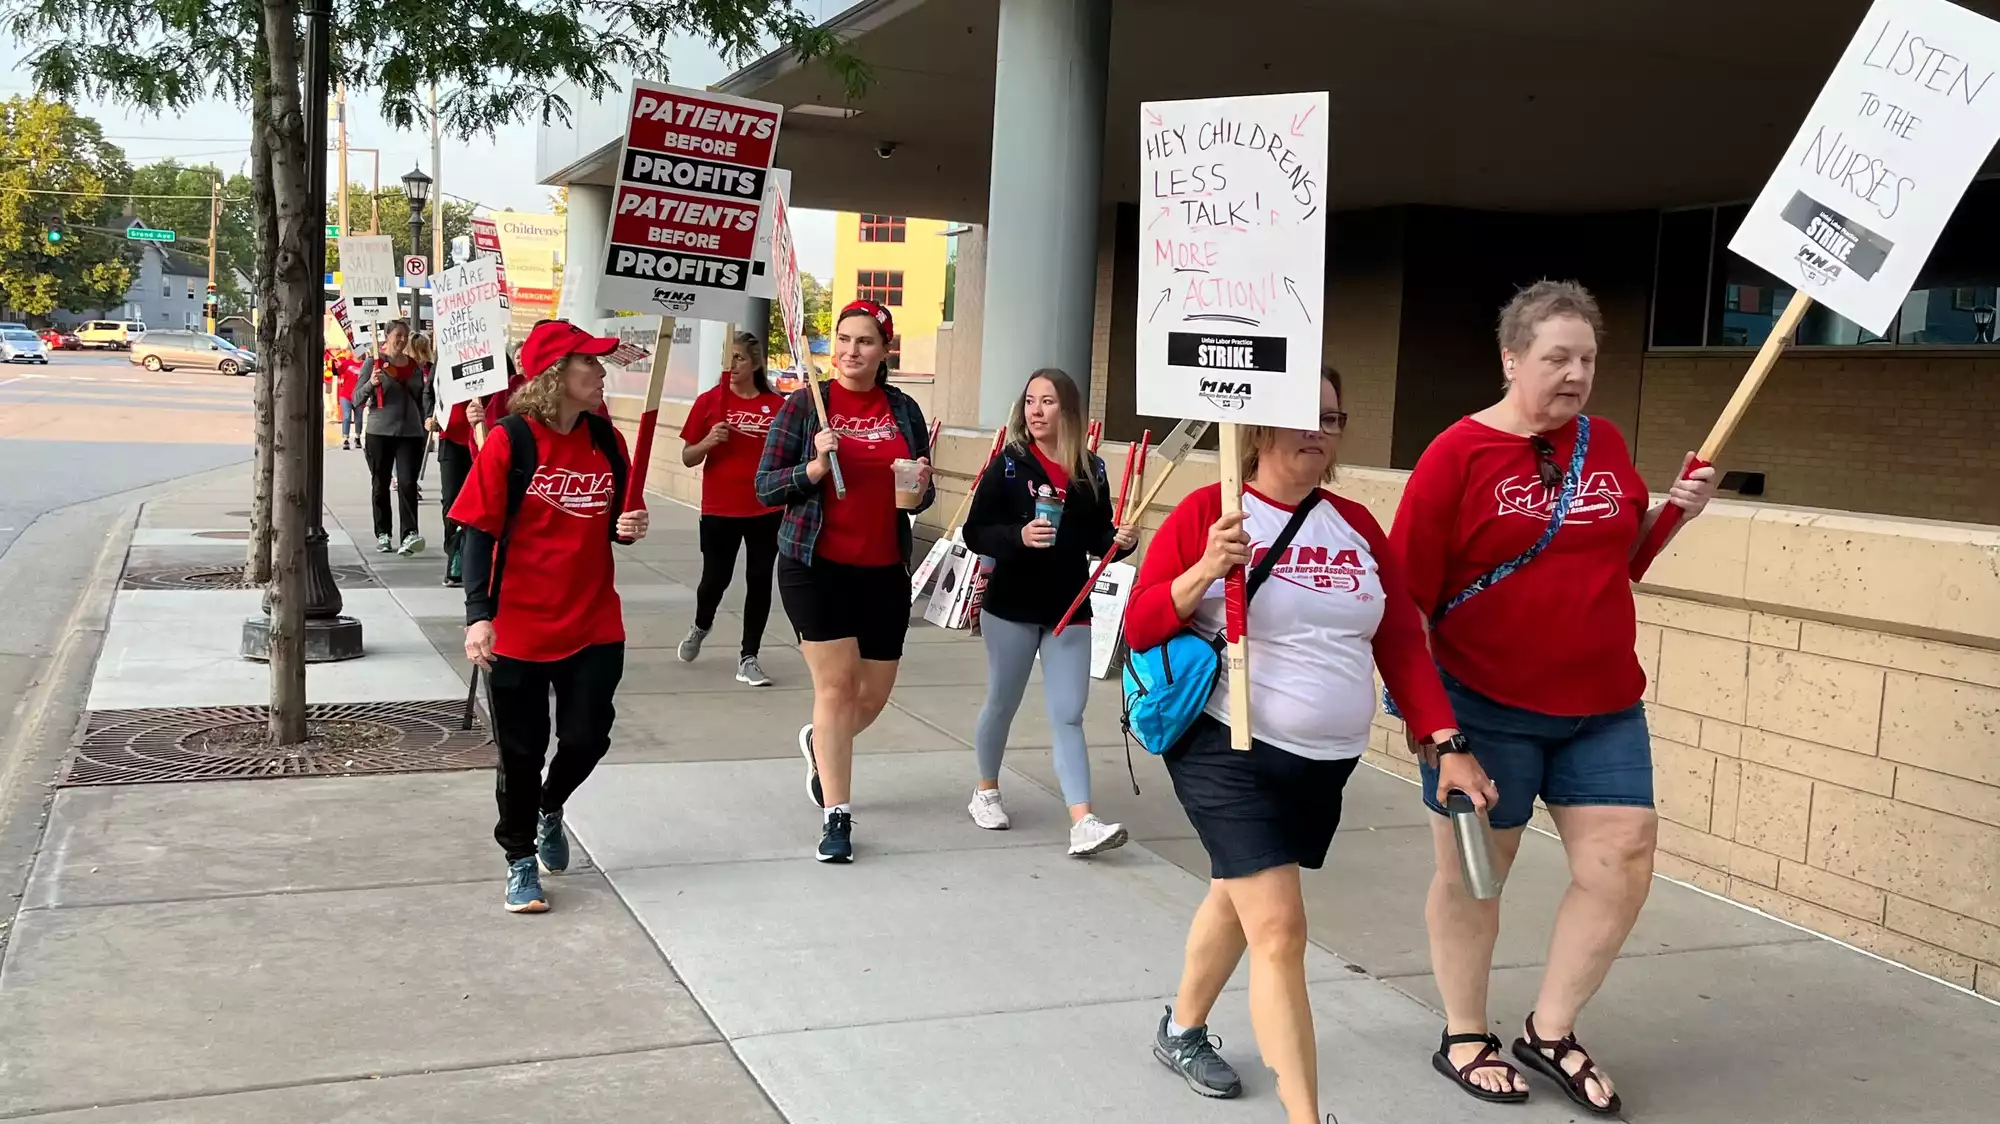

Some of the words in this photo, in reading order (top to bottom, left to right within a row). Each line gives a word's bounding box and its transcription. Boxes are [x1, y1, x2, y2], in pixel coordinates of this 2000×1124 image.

[1863, 20, 1995, 105] LISTEN
[634, 96, 775, 140] PATIENTS
[1858, 92, 1880, 117] TO
[1883, 104, 1922, 140] THE
[664, 132, 737, 157] BEFORE
[1146, 124, 1187, 160] HEY
[632, 155, 756, 195] PROFITS
[1155, 164, 1227, 198] LESS
[1800, 125, 1915, 220] NURSES
[618, 193, 757, 232] PATIENTS
[1180, 192, 1260, 226] TALK!
[503, 222, 559, 237] Children's
[648, 227, 720, 250] BEFORE
[1806, 217, 1855, 261] STRIKE
[616, 250, 740, 285] PROFITS
[1156, 239, 1219, 267] MORE
[1798, 248, 1842, 277] MNA
[433, 274, 452, 294] WE
[459, 266, 485, 287] ARE
[436, 282, 500, 316] EXHAUSTED
[654, 289, 696, 302] MNA
[450, 305, 474, 325] SAFE
[442, 317, 486, 344] STAFFING
[458, 340, 491, 361] NOW!
[1198, 345, 1254, 368] STRIKE
[1201, 381, 1251, 395] MNA
[526, 473, 614, 494] MNA
